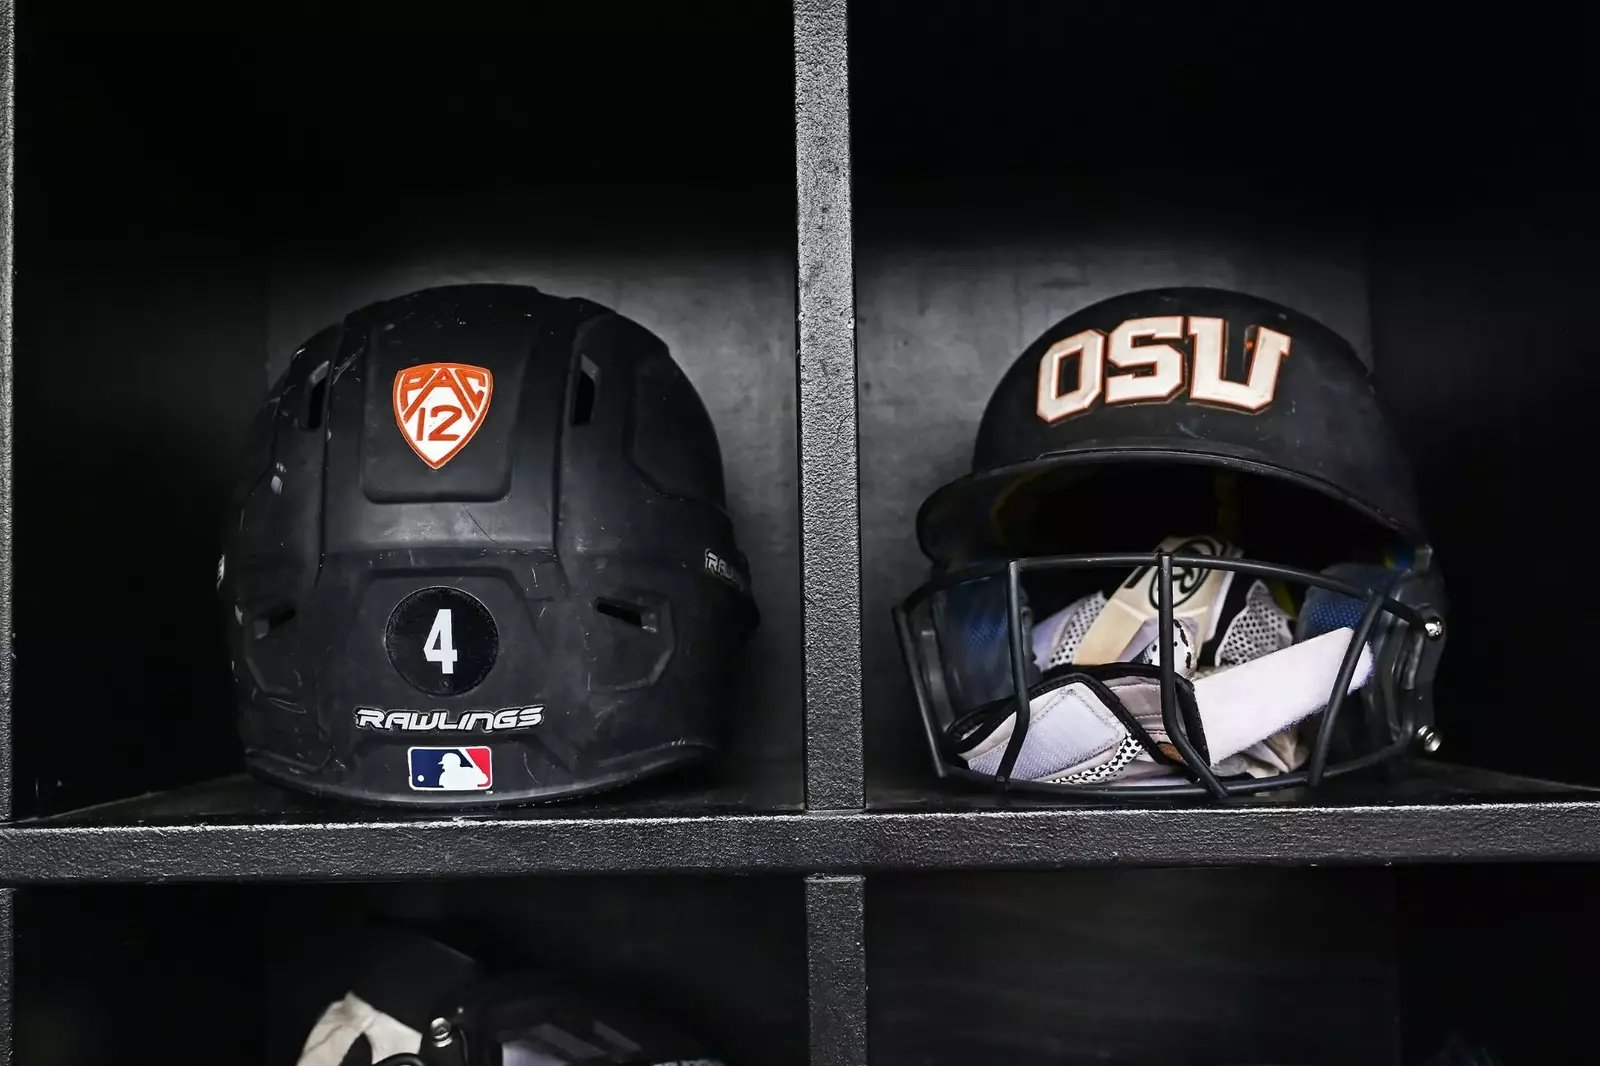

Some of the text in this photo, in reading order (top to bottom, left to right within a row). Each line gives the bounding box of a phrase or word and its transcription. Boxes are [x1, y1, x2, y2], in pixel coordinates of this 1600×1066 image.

[400, 367, 486, 423] PAC
[1037, 315, 1292, 424] OSU
[415, 405, 463, 441] 12
[423, 608, 458, 674] 4
[356, 705, 545, 731] RAWLINGS
